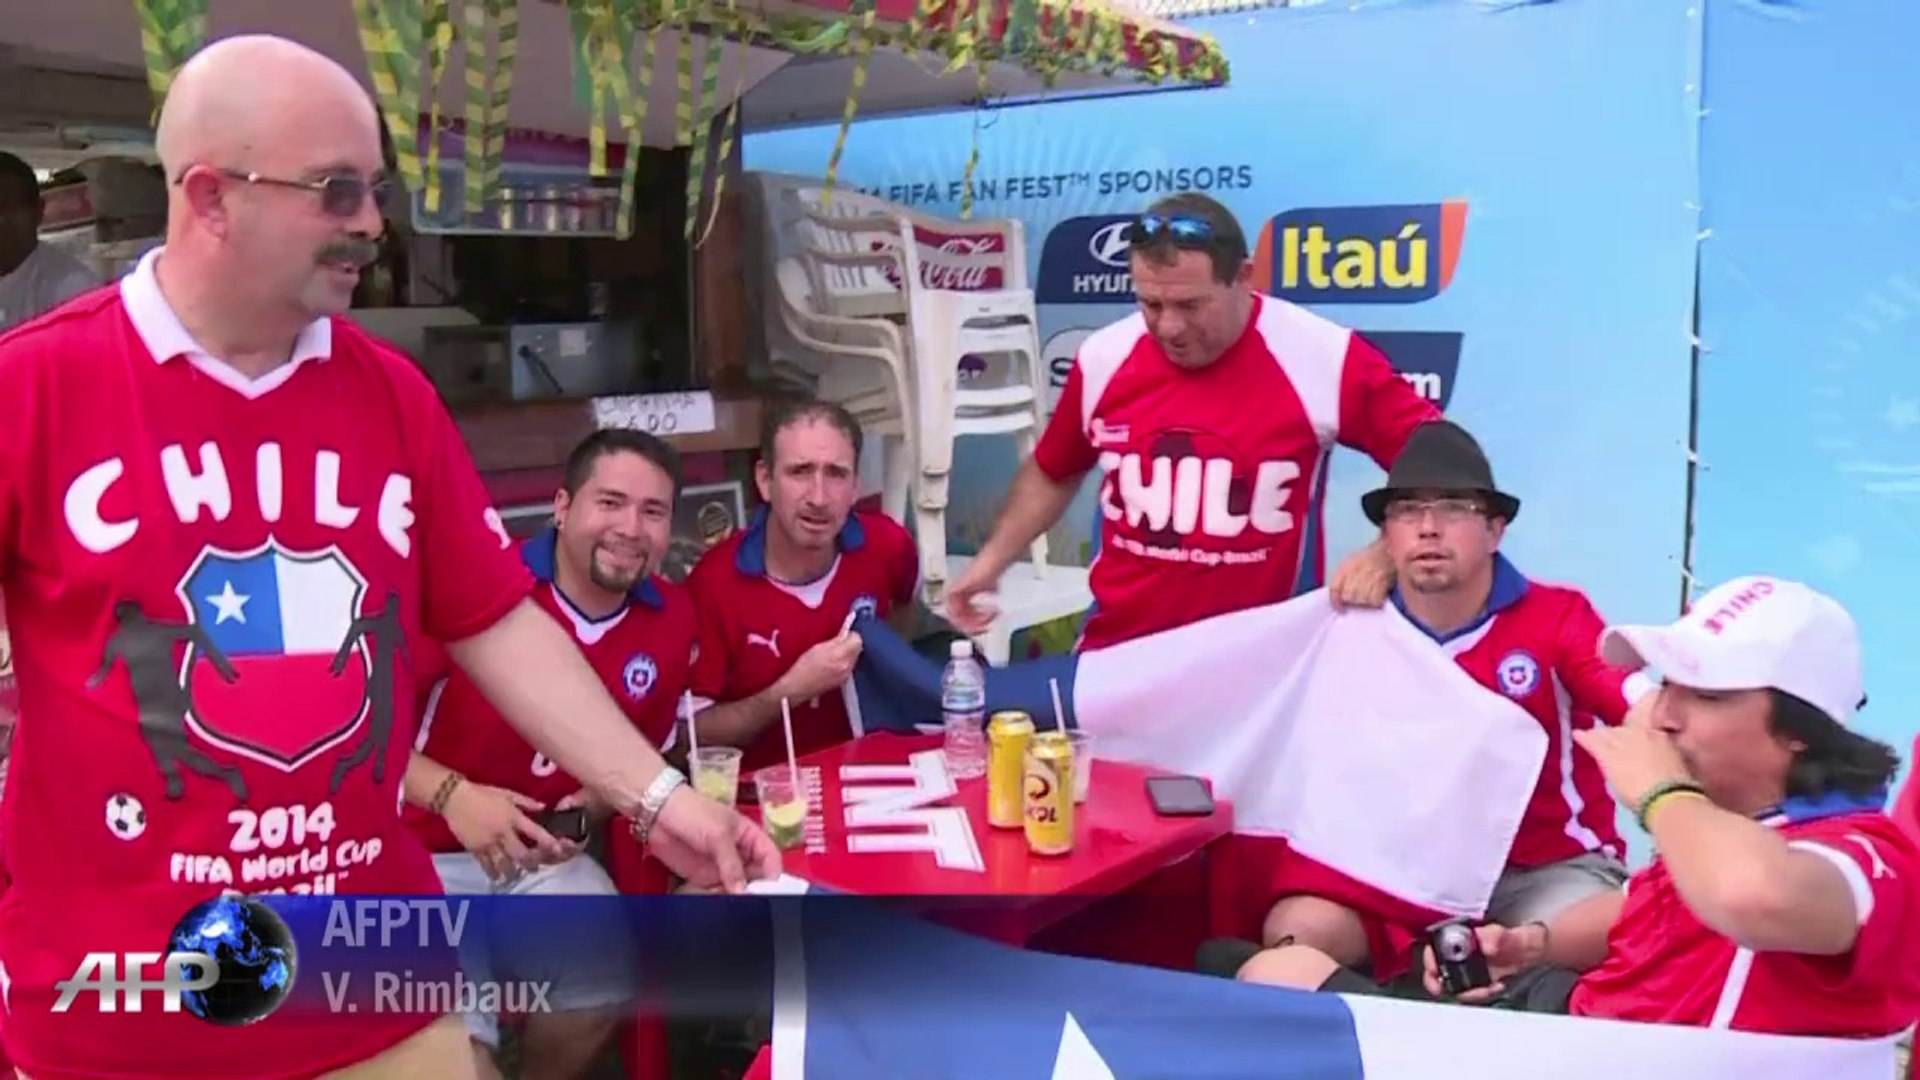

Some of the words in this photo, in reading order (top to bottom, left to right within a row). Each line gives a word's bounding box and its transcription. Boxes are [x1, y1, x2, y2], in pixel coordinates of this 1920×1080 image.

[890, 182, 939, 206] FIFA
[1099, 165, 1253, 195] SPONSORS
[1282, 223, 1428, 289] Itaú
[63, 440, 416, 559] CHILE
[1101, 450, 1300, 537] CHILE
[1702, 580, 1775, 637] CHILE
[227, 802, 337, 854] 2014
[838, 747, 987, 874] TNT
[170, 852, 233, 885] FIFA
[242, 846, 329, 883] World
[335, 837, 383, 868] Cup
